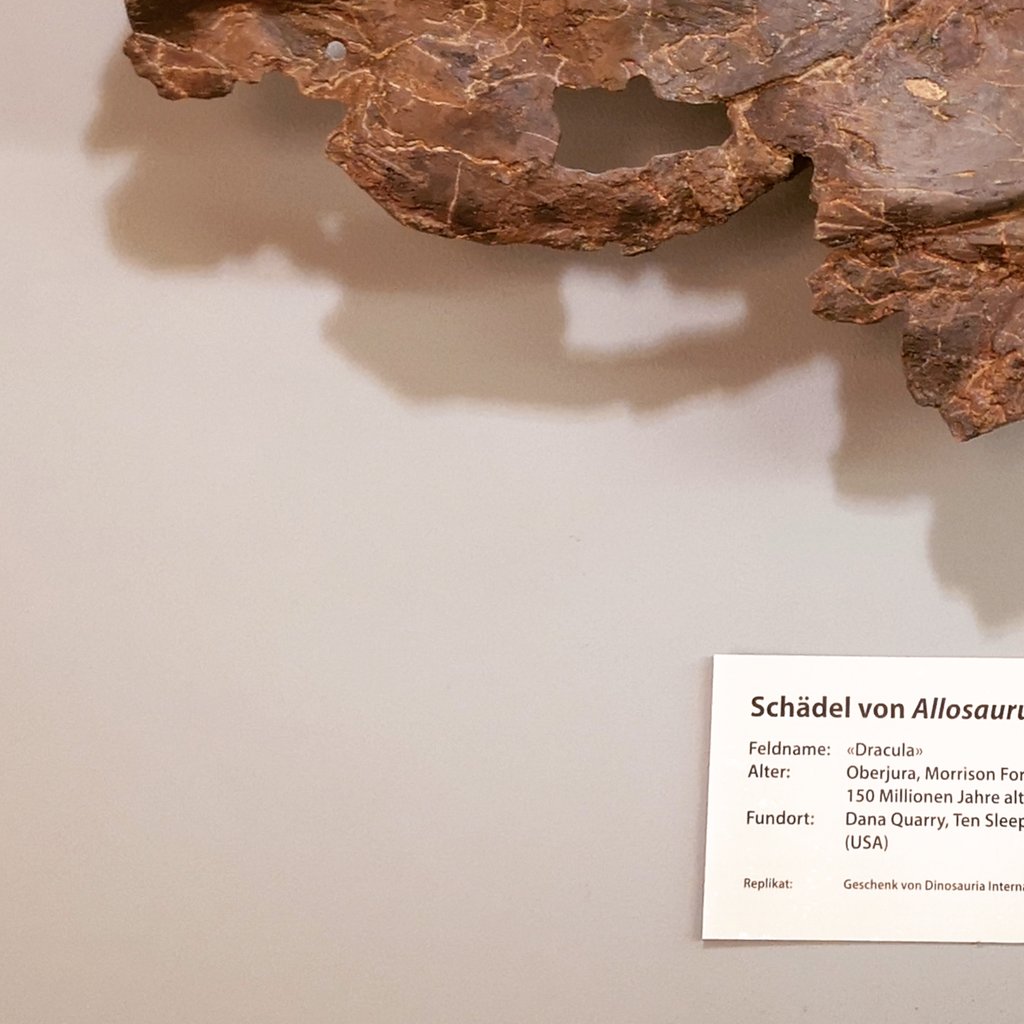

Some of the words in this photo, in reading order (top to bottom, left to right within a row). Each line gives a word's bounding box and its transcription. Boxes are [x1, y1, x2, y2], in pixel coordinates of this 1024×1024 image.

[750, 695, 851, 719] Schädel
[858, 702, 905, 719] von
[749, 740, 831, 756] Feldname:
[847, 742, 923, 757] «Dracula»
[747, 763, 790, 779] Alter:
[846, 765, 921, 783] Oberjura,
[925, 766, 996, 781] Morrison
[847, 788, 875, 803] 150
[879, 788, 953, 804] Millionen
[957, 789, 1000, 804] Jahre
[1004, 789, 1024, 805] alt
[746, 810, 815, 826] Fundort:
[845, 811, 886, 827] Dana
[891, 812, 949, 831] Quarry,
[953, 813, 980, 828] Ten
[845, 834, 889, 852] (USA)
[743, 877, 793, 890] Replikat:
[843, 878, 898, 891] Geschenk
[901, 882, 922, 892] von
[924, 879, 986, 893] Dinosauria
